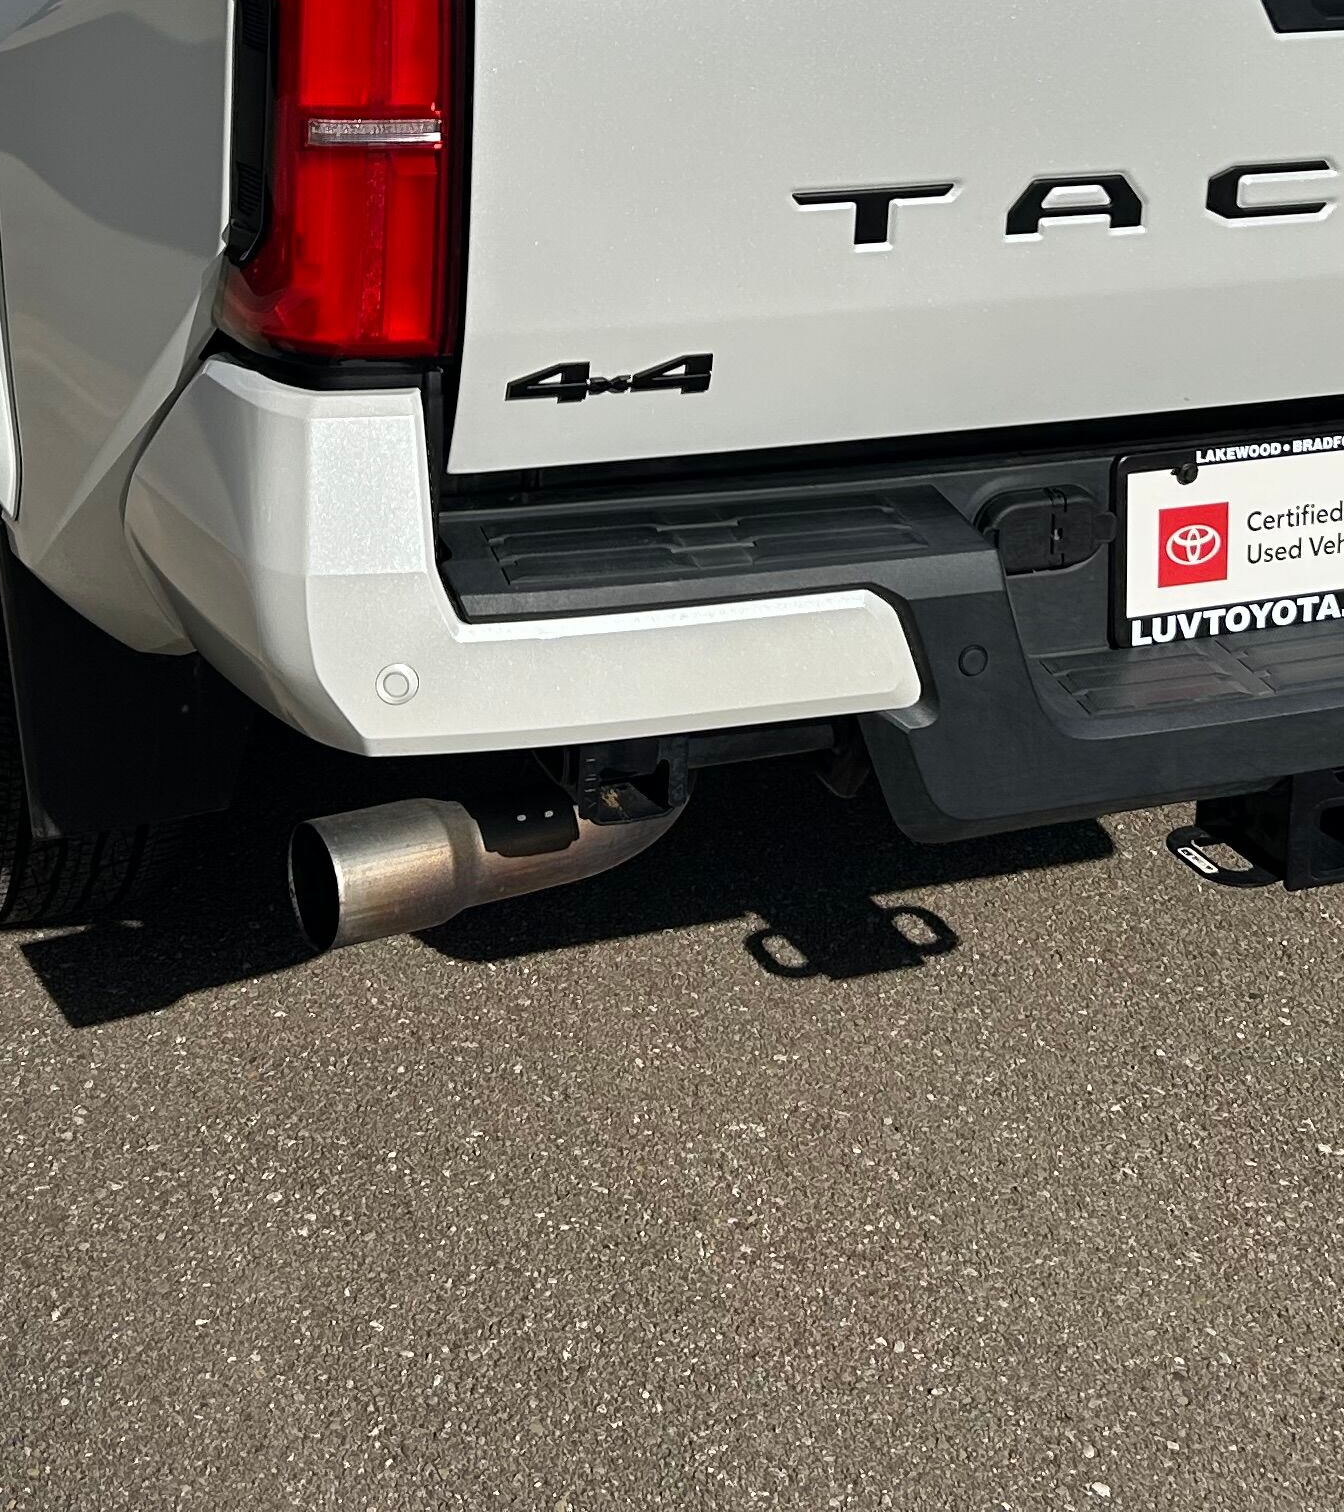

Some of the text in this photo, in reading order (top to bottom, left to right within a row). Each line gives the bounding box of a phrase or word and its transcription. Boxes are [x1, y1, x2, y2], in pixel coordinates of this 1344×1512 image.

[1196, 442, 1281, 464] LAKEWOOD
[1247, 500, 1344, 532] Certified
[1247, 541, 1302, 565] Used
